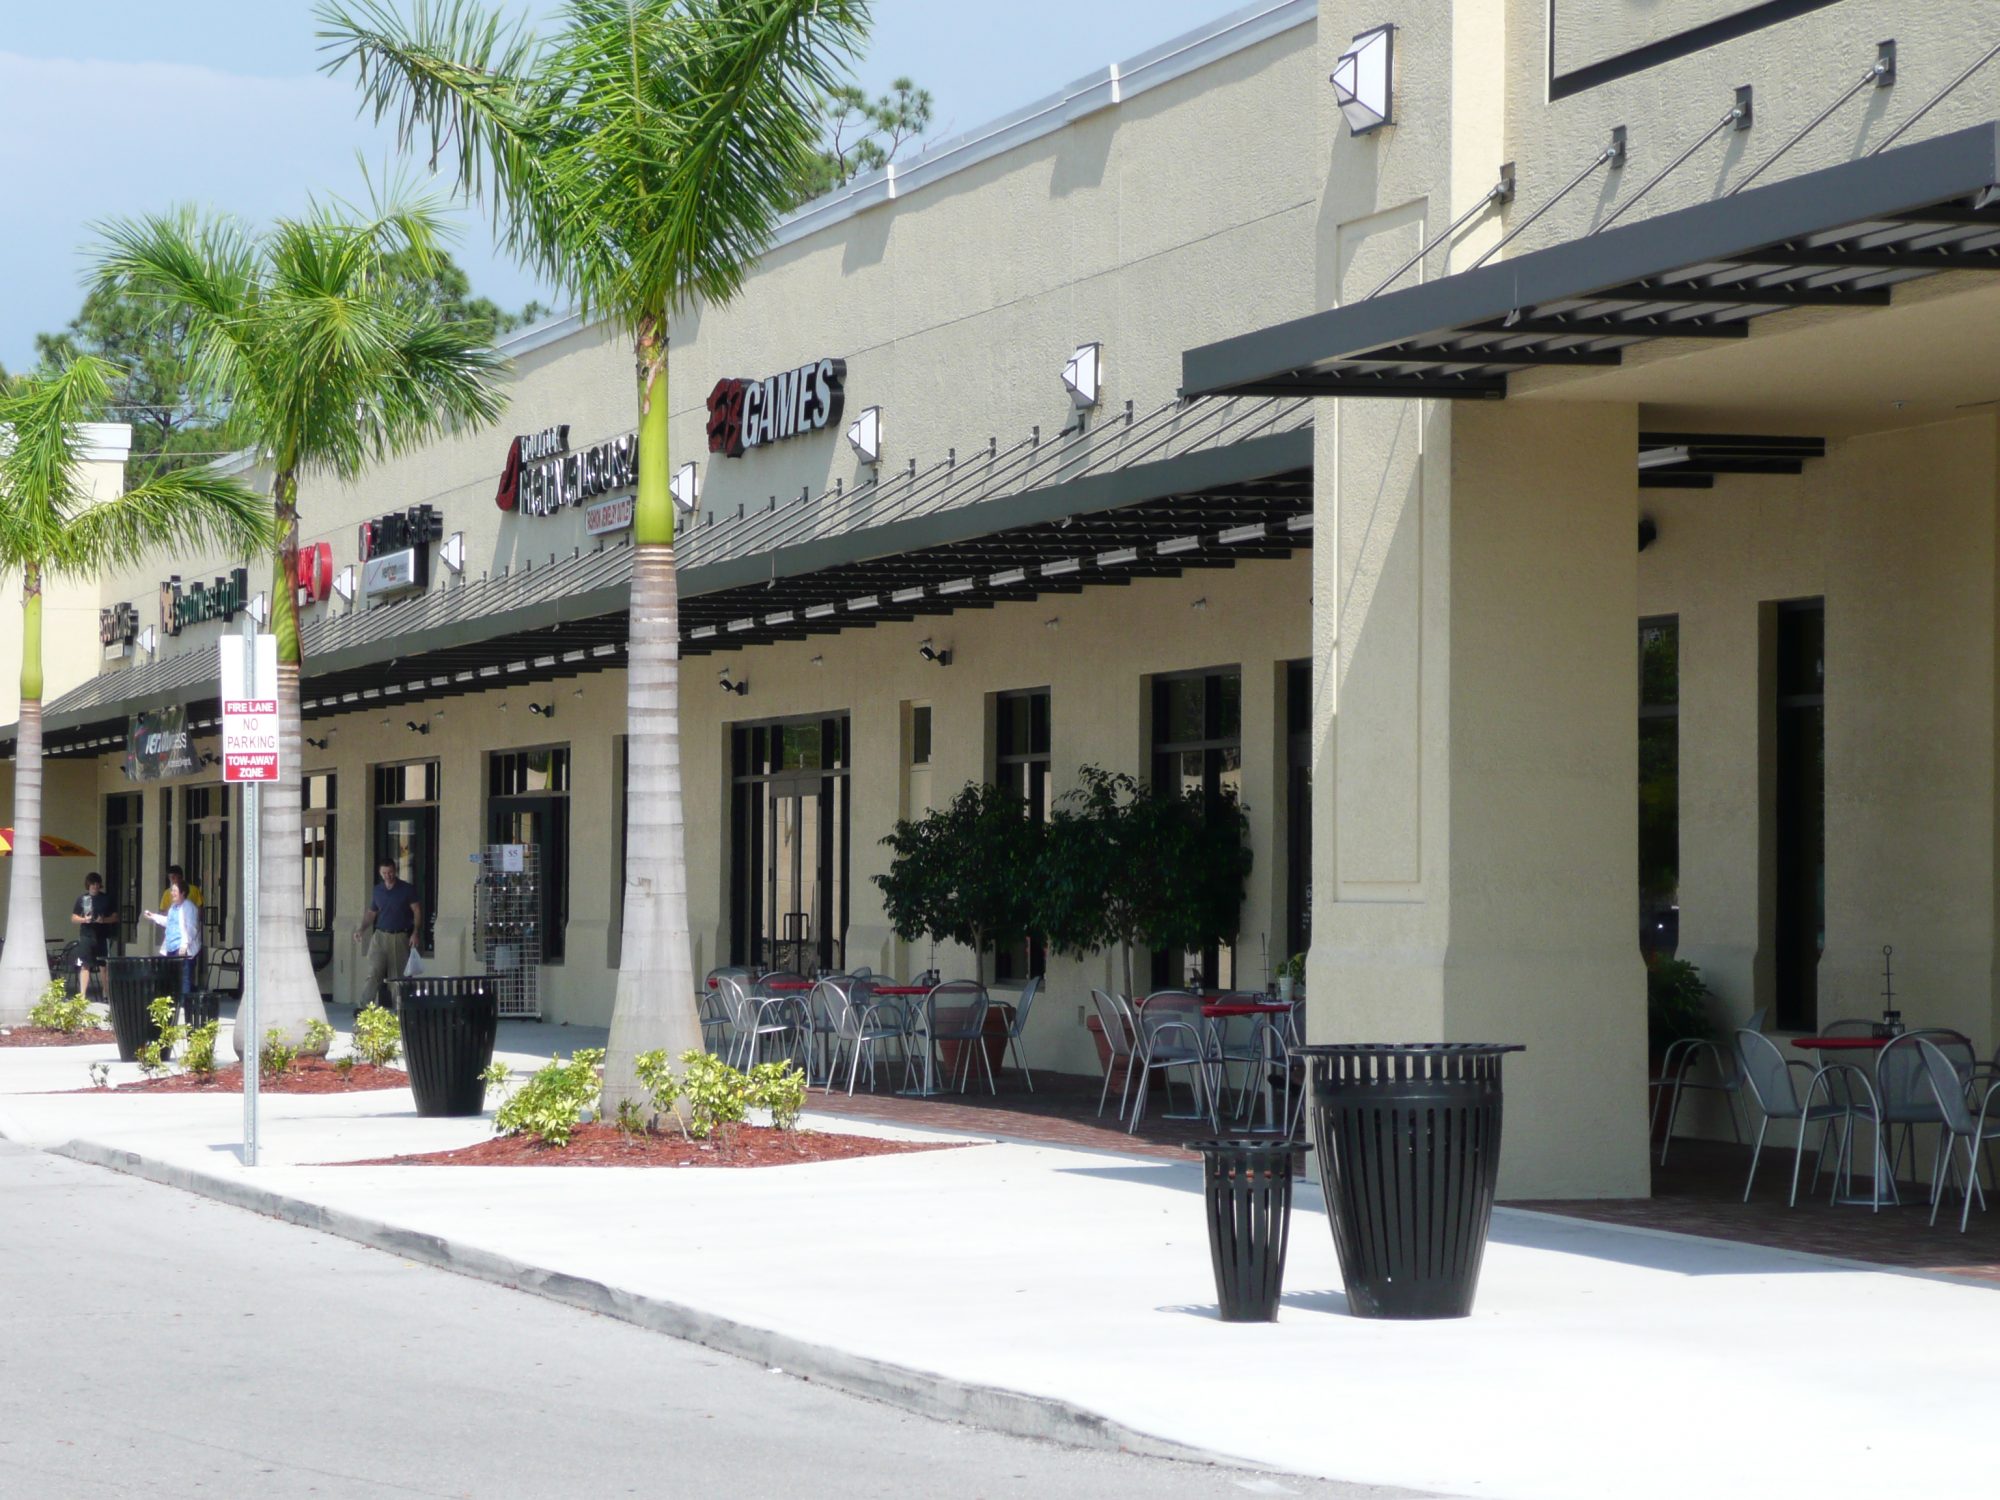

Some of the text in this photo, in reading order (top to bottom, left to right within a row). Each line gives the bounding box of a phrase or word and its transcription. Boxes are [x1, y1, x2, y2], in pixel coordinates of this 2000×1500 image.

[706, 358, 840, 458] EB GAMES
[227, 702, 274, 712] FIRE LANE
[243, 718, 258, 731] NO
[227, 735, 275, 749] PARKING
[228, 755, 275, 766] TOW-AWAY
[239, 768, 264, 778] ZONE
